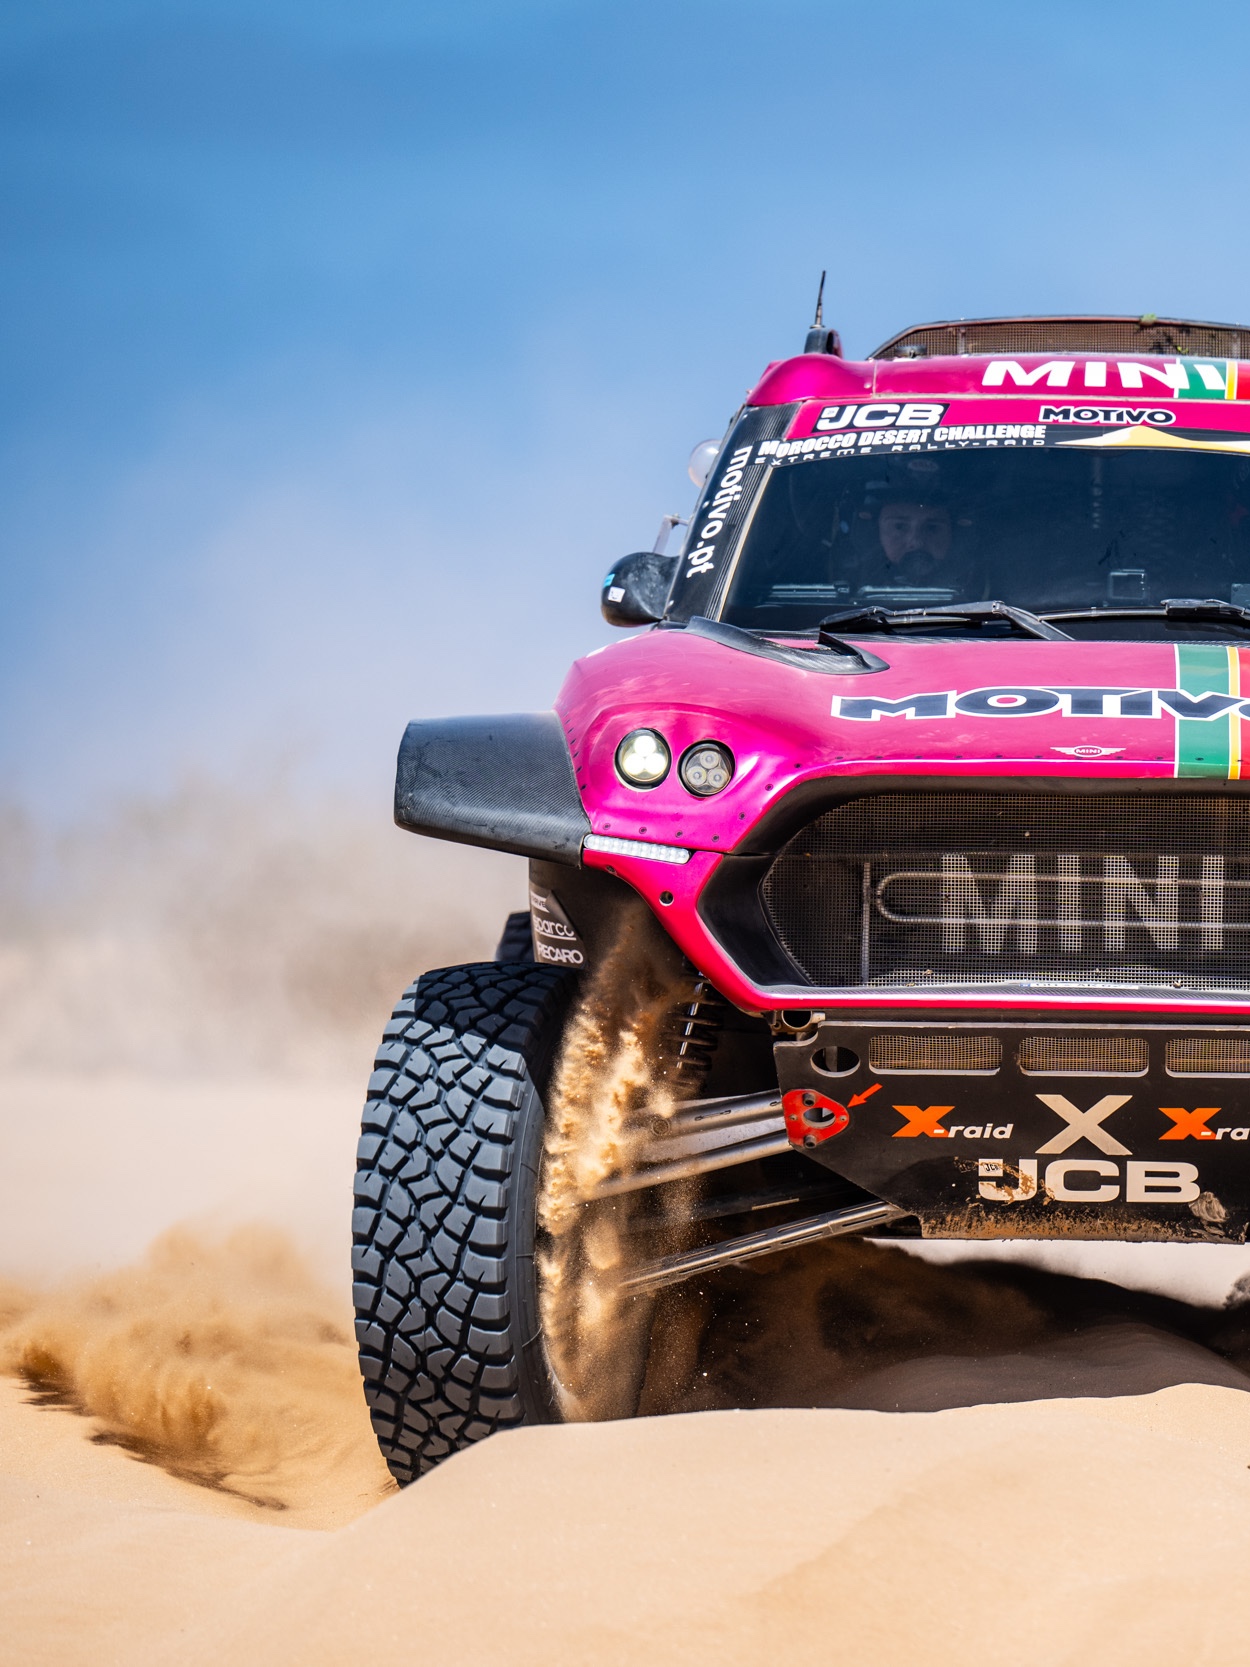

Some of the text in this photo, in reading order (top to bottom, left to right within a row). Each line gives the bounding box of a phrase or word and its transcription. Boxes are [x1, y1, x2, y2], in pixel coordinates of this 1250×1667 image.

[981, 361, 1227, 390] MINI
[815, 404, 945, 431] JCB
[1039, 405, 1176, 425] MOTIVO
[754, 446, 872, 466] EXTREME
[757, 425, 1046, 457] MOROCCO DESERT CHALLENGE
[686, 445, 753, 578] motivo.pt
[940, 853, 1225, 955] MINI
[536, 940, 584, 964] RECARO
[891, 1105, 1014, 1139] X-raid
[978, 1158, 1201, 1203] JCB
